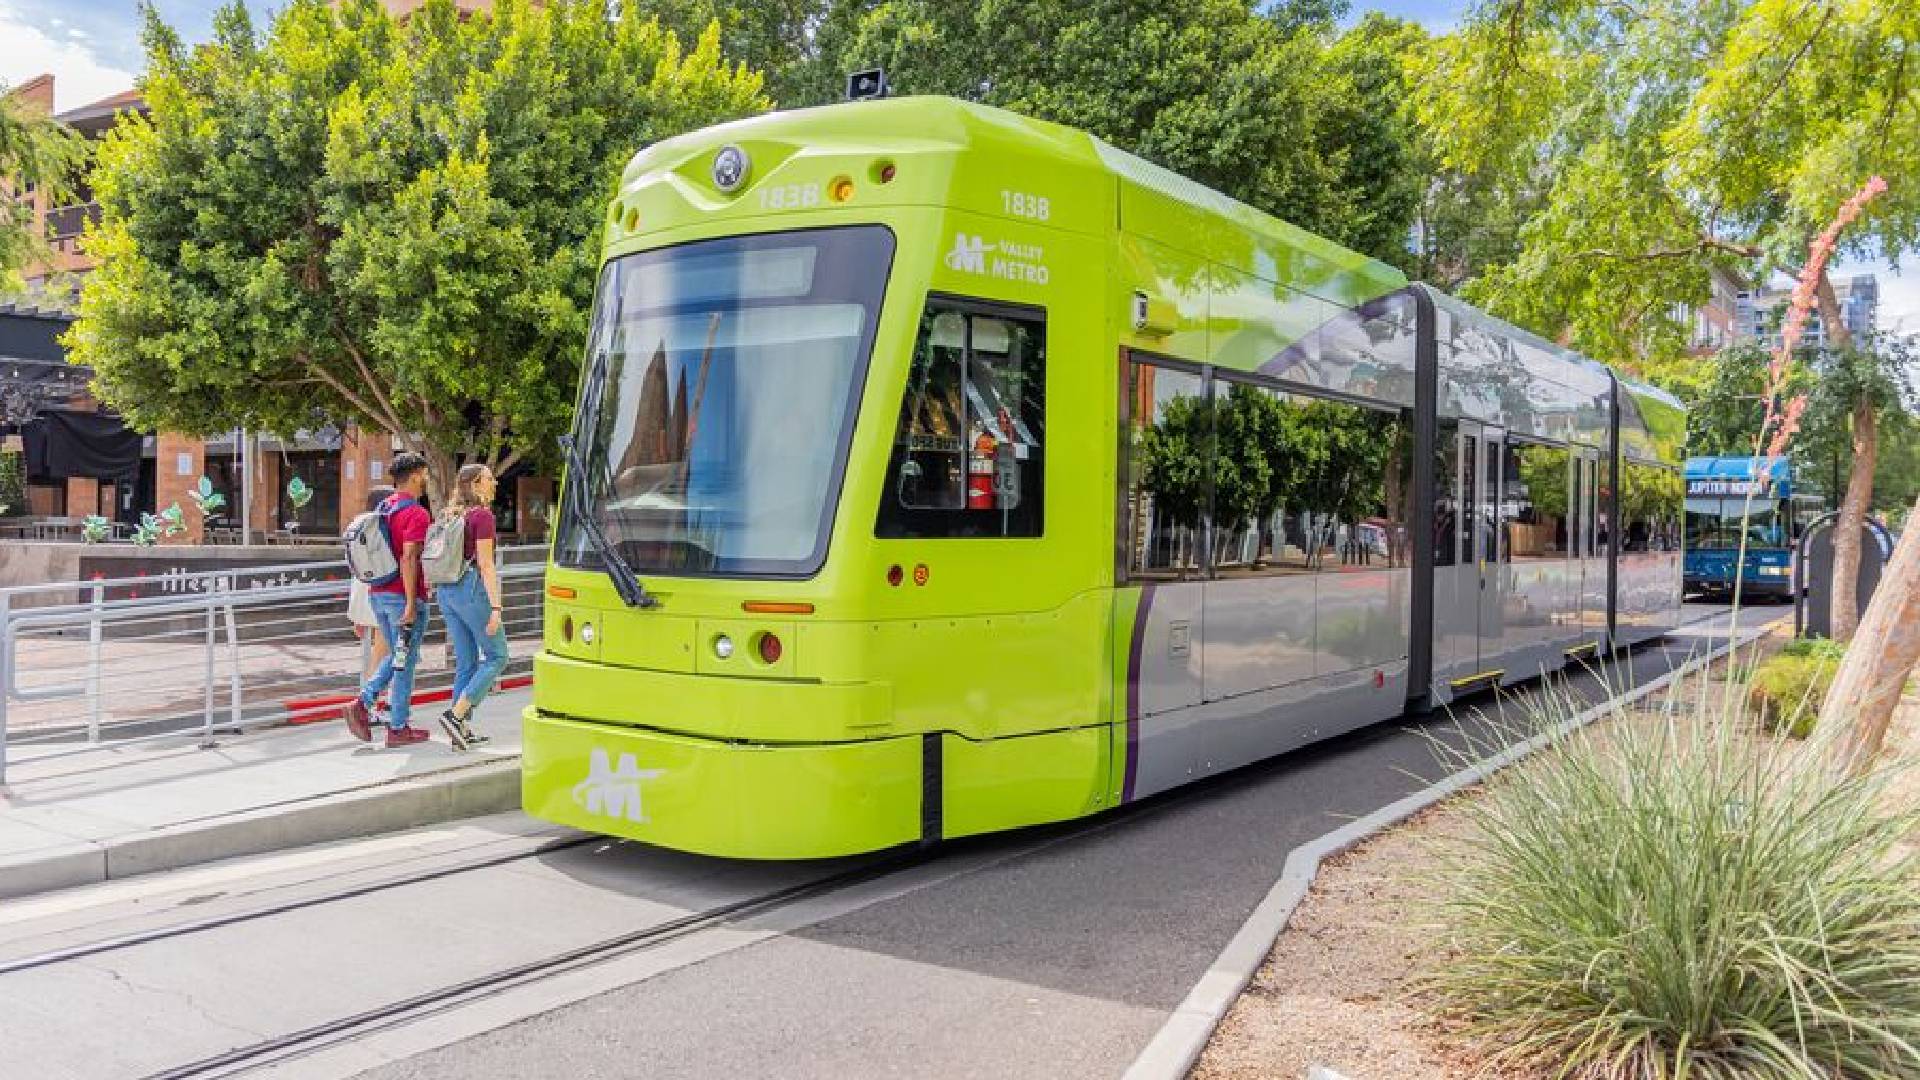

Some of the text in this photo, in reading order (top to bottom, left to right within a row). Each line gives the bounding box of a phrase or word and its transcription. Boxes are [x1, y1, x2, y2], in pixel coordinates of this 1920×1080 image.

[758, 183, 820, 209] 183B
[1000, 191, 1050, 220] 183B
[1000, 239, 1044, 259] VALLEY
[992, 258, 1049, 284] METRO
